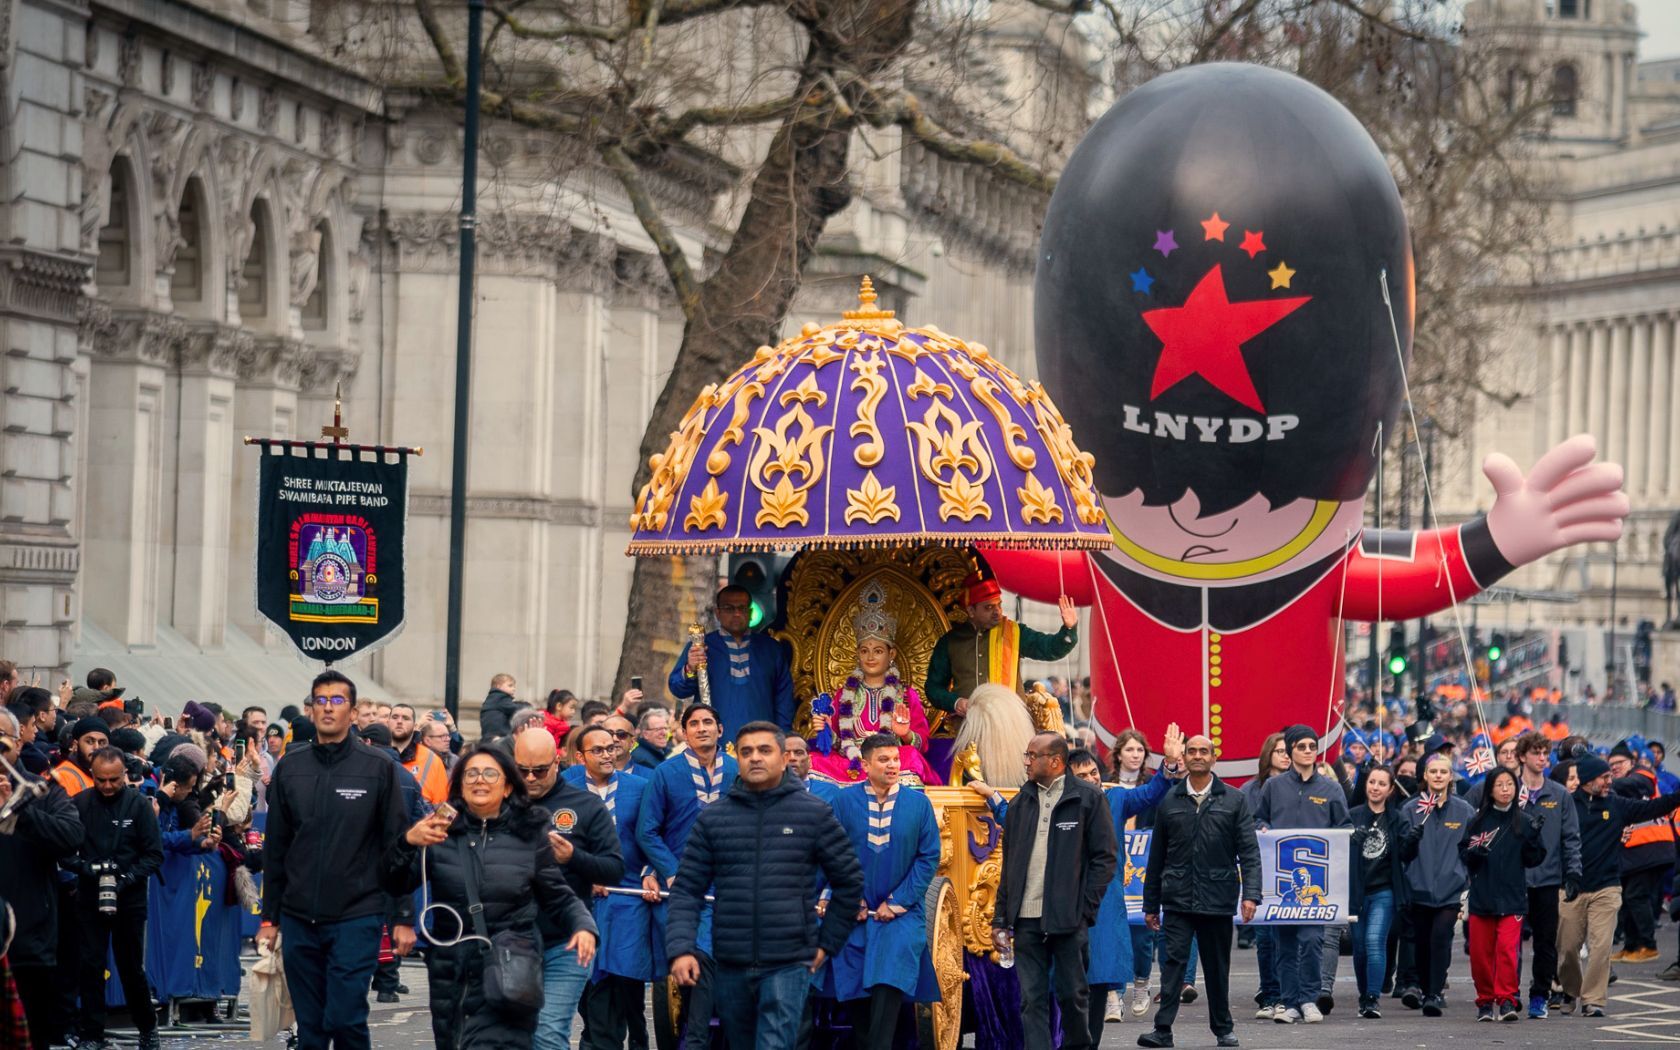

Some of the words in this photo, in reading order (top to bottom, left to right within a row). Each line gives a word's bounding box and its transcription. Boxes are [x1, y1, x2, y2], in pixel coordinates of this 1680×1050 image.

[1123, 404, 1299, 443] LNYDP
[284, 476, 312, 489] SHREE
[315, 480, 383, 494] MUKTAJEEVAN
[335, 494, 357, 505] PIPE
[360, 495, 389, 507] BAND
[302, 636, 357, 651] LONDON
[1265, 904, 1337, 922] PIONEERS
